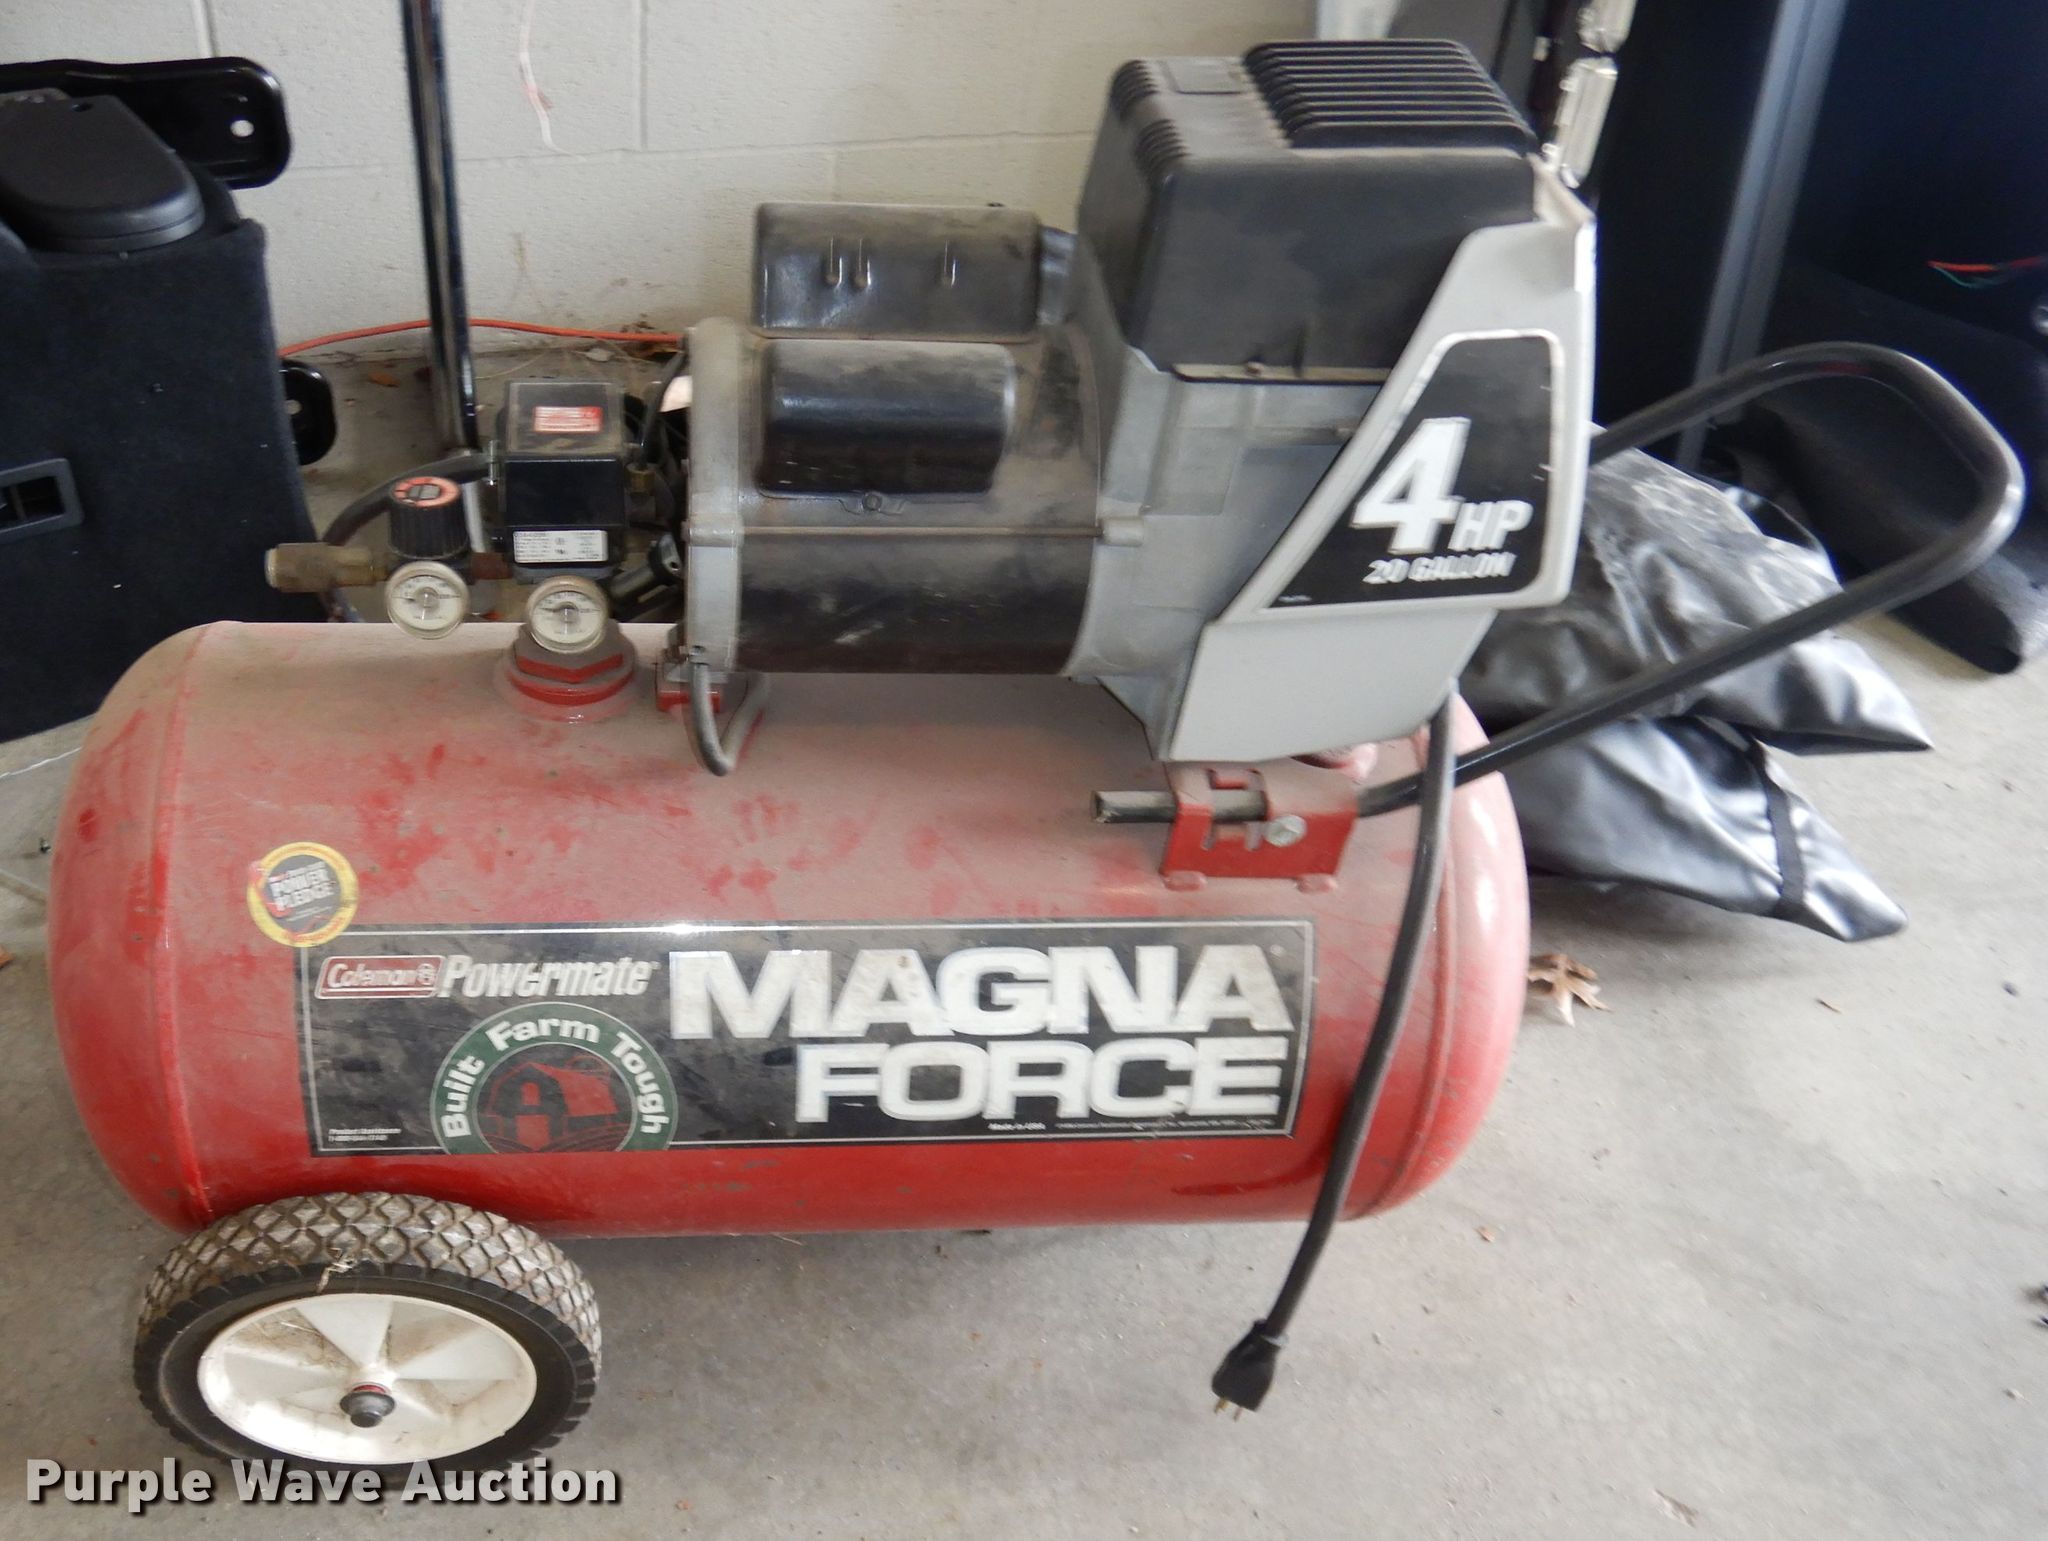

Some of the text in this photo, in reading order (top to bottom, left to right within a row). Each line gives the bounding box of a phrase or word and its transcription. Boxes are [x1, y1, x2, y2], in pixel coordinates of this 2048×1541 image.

[1352, 416, 1471, 555] 4
[1447, 500, 1534, 551] HP
[1362, 551, 1517, 584] 20 GALLON
[438, 954, 651, 998] Powermate
[668, 944, 1295, 1040] MAGNA
[440, 1017, 670, 1138] Built Farm Tough
[794, 1036, 1289, 1123] FORCE
